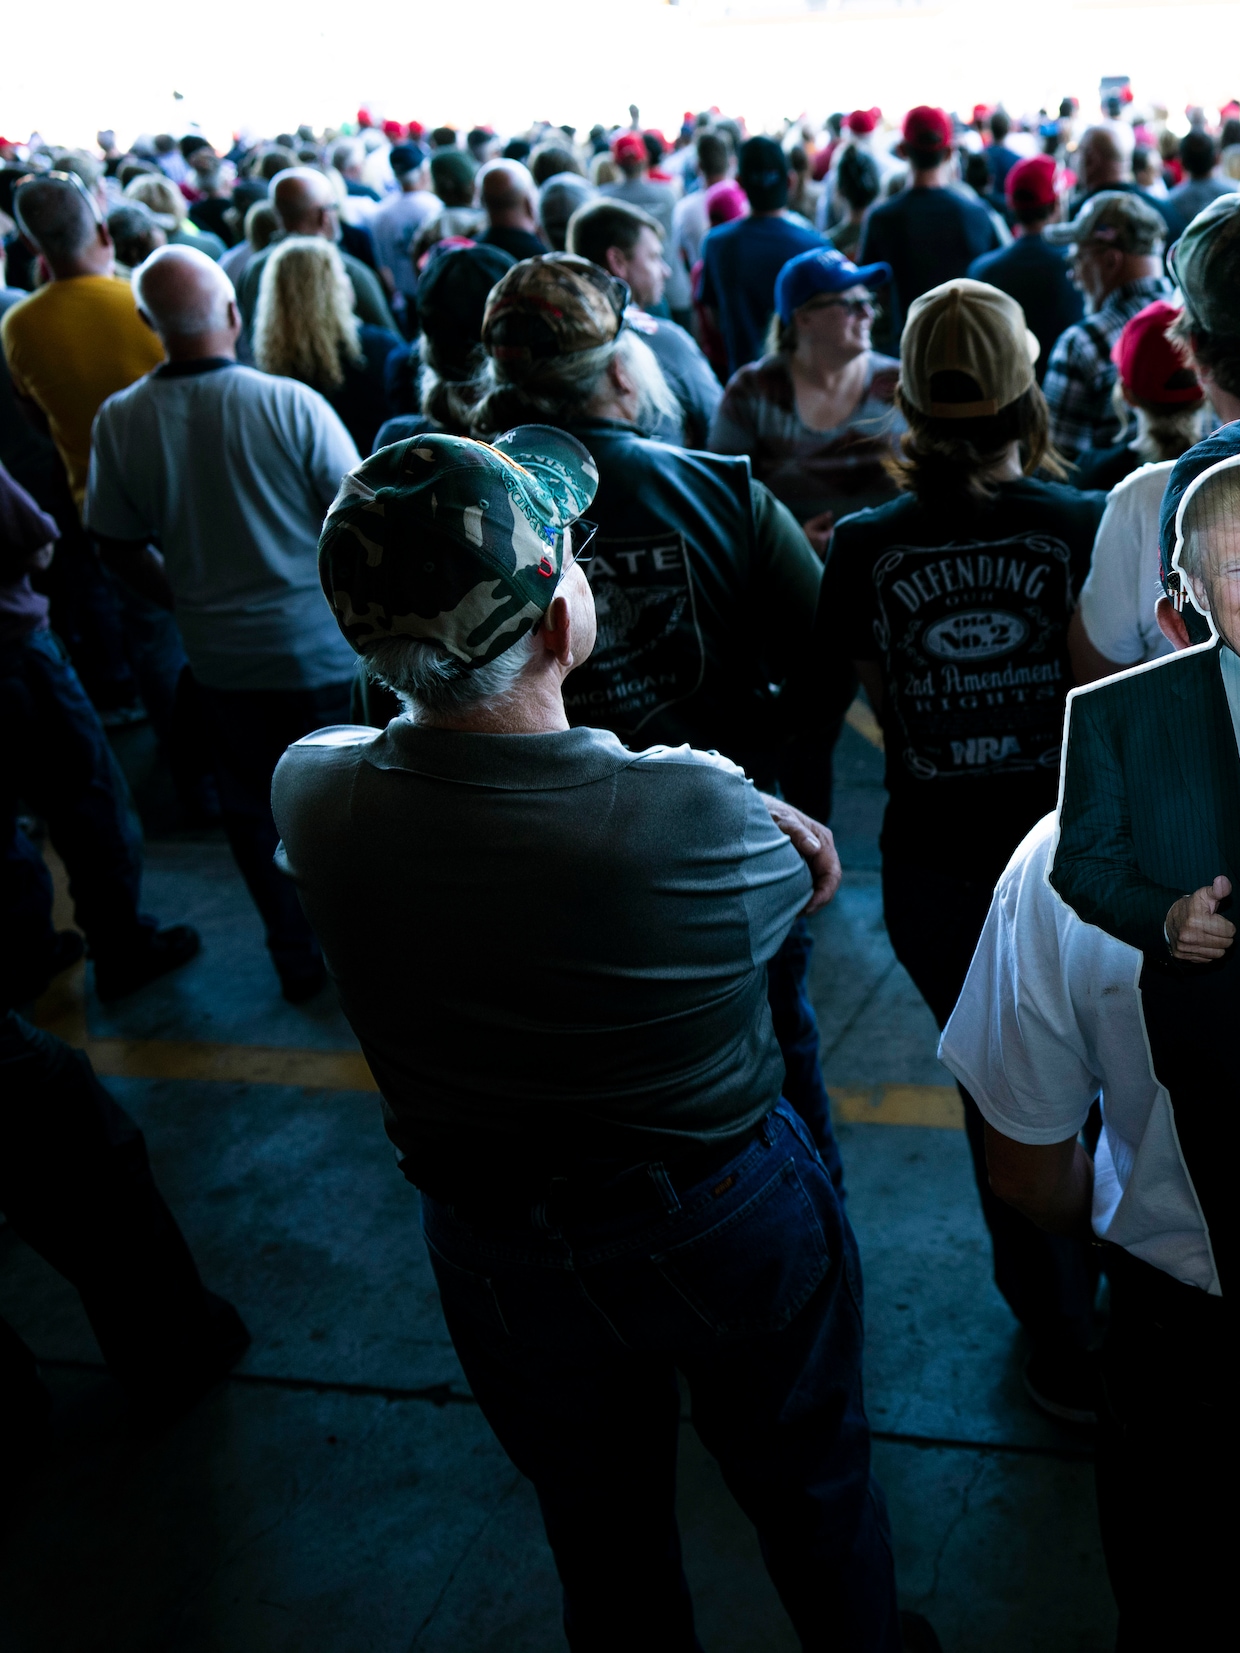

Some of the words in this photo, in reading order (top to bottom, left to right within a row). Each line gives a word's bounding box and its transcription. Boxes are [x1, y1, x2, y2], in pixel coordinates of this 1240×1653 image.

[537, 525, 556, 579] USA
[890, 553, 1051, 615] DEFENDING
[945, 591, 996, 608] OUR
[563, 671, 677, 708] MICHIGAN
[903, 670, 936, 697] 2nd
[940, 656, 1063, 695] Amendment
[915, 684, 1056, 712] RIGHTS
[949, 734, 1022, 766] NRA
